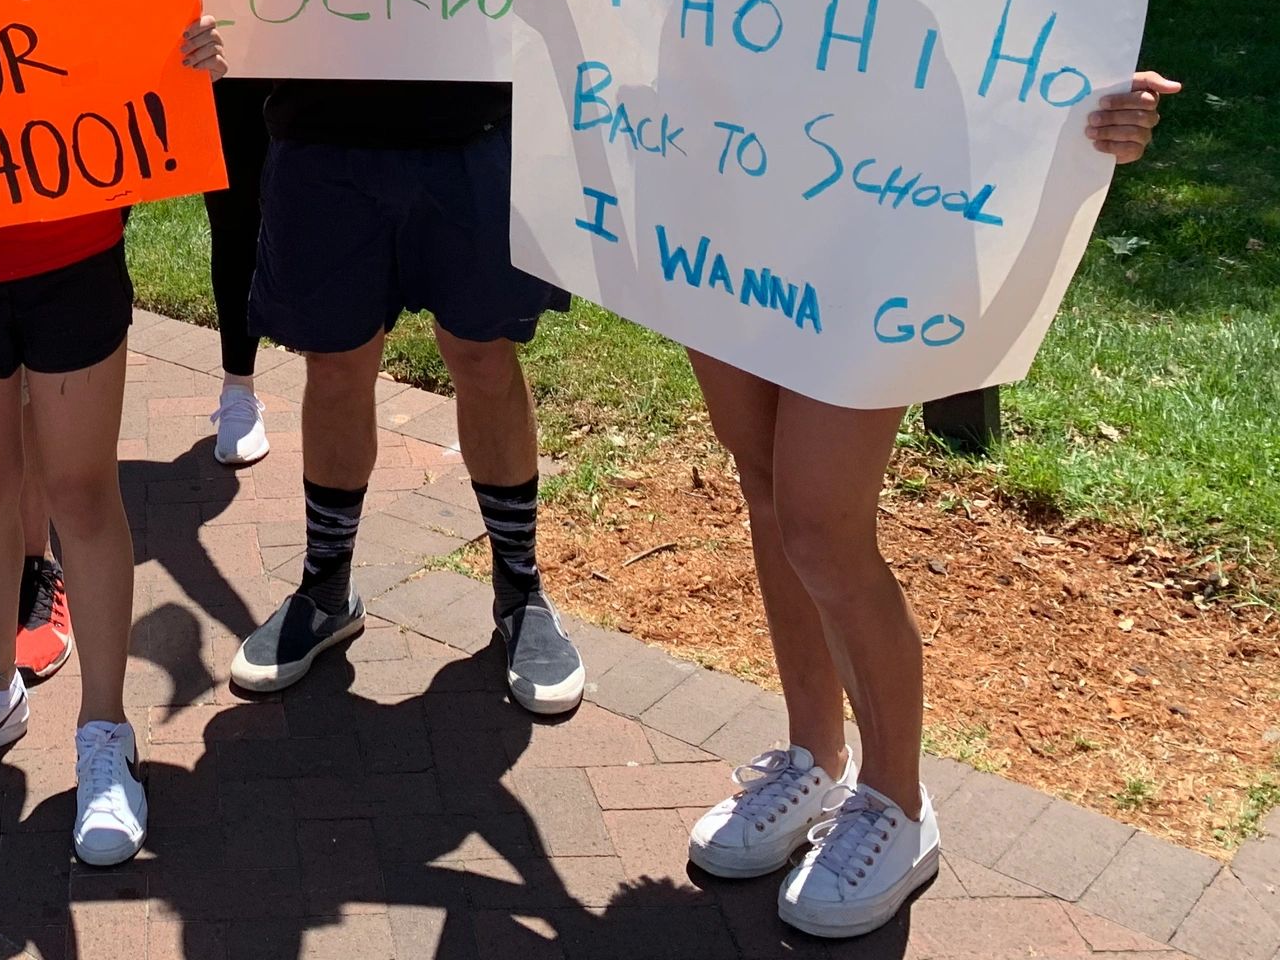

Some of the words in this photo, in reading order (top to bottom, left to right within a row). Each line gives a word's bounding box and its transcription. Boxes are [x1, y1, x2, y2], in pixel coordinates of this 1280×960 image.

[572, 60, 688, 158] BACK
[713, 120, 767, 177] TO
[803, 112, 1004, 227] SCHOOL
[574, 186, 618, 244] I
[655, 224, 823, 335] WANNA
[873, 297, 966, 347] GO
